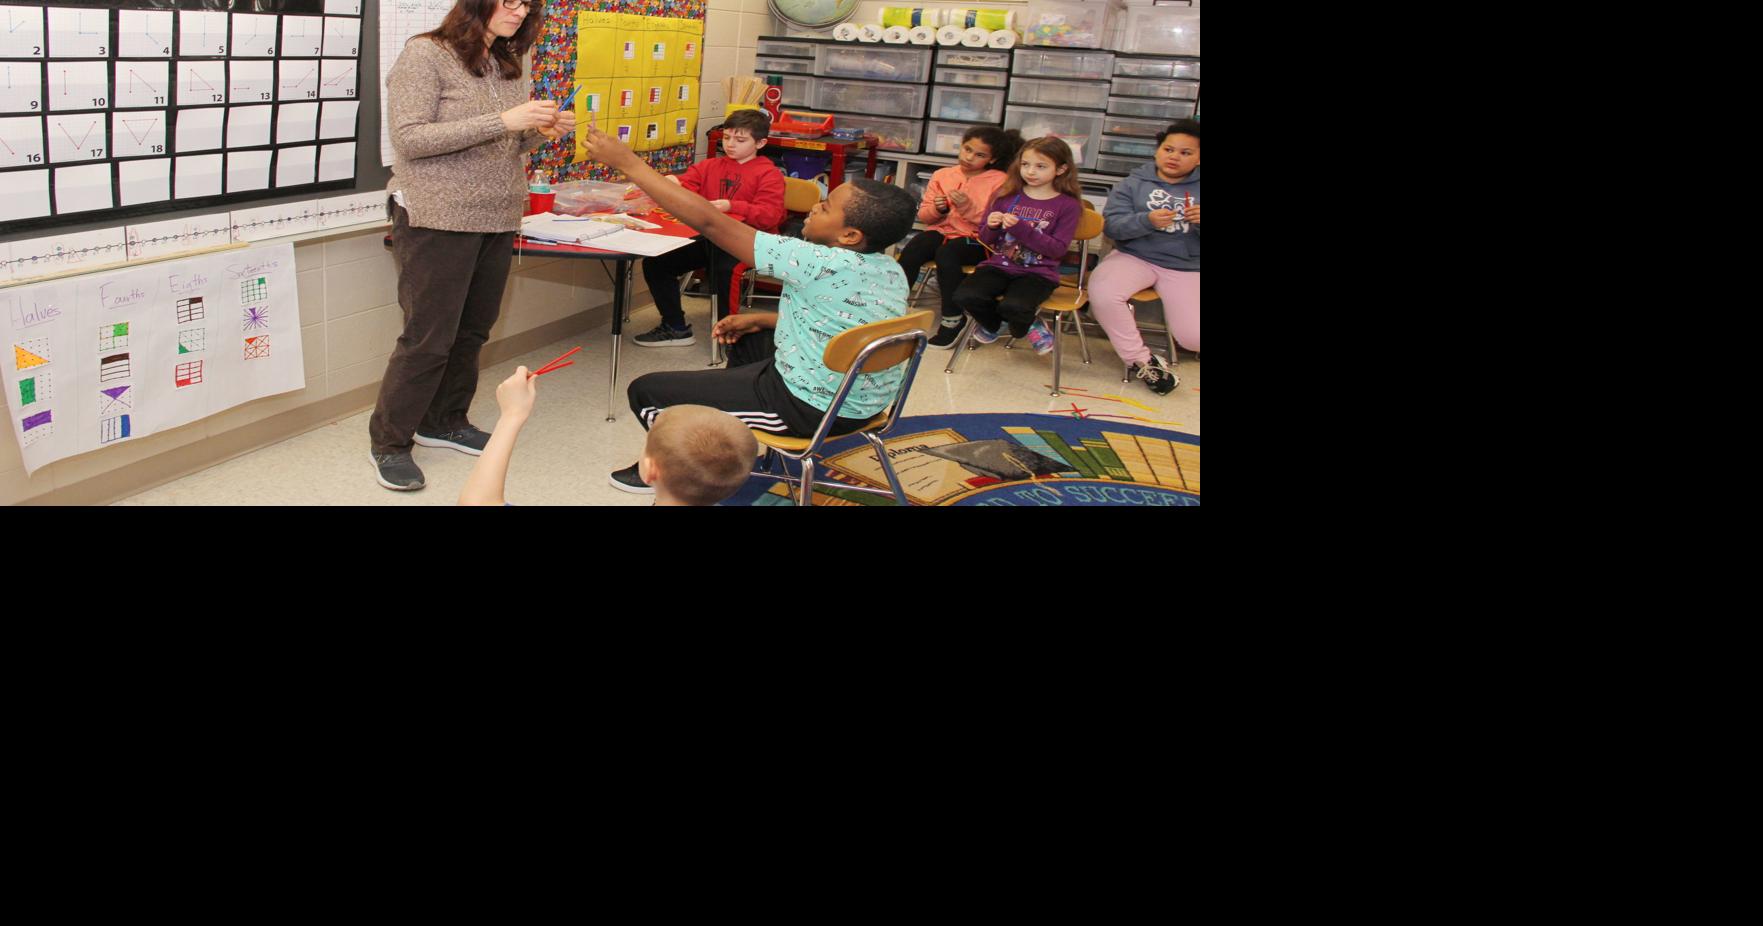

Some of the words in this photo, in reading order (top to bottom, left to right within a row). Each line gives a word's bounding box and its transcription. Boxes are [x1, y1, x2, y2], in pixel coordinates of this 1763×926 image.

[33, 46, 41, 55] 2
[98, 46, 106, 55] 3
[162, 46, 170, 55] 4
[218, 45, 225, 54] 5
[267, 47, 274, 55] 6
[314, 47, 320, 55] 7
[351, 47, 357, 55] 8
[260, 92, 271, 100] 13
[306, 90, 316, 98] 14
[346, 88, 354, 96] 15
[92, 97, 106, 107] 10
[154, 96, 165, 105] 11
[212, 94, 223, 102] 12
[30, 100, 39, 110] 9
[91, 148, 104, 158] 17
[151, 144, 163, 153] 18
[26, 153, 41, 163] 16
[9, 296, 61, 326] Halves
[868, 443, 930, 462] Dploma
[1014, 488, 1063, 507] TO
